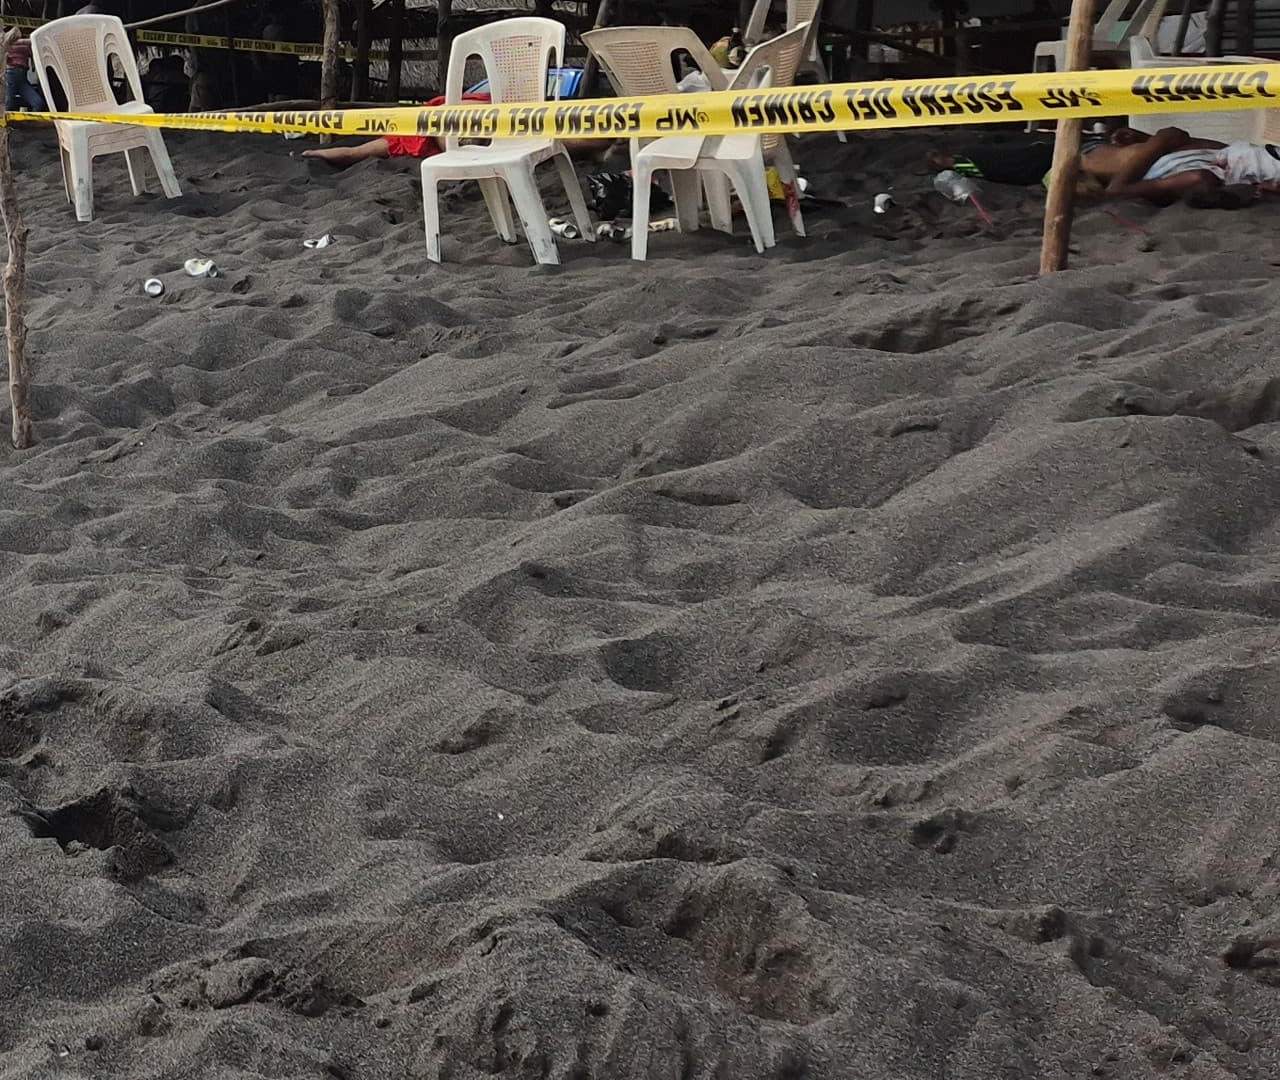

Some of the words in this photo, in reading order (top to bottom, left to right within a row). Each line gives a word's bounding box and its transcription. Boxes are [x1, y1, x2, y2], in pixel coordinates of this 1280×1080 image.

[732, 92, 837, 128] CRIMEN
[844, 89, 897, 121] DEL
[902, 81, 1023, 118] ESCENA
[1040, 87, 1101, 109] MP
[417, 110, 498, 137] CRIMEN
[510, 108, 551, 137] DEL
[555, 104, 643, 136] ESCENA
[656, 107, 699, 132] MP
